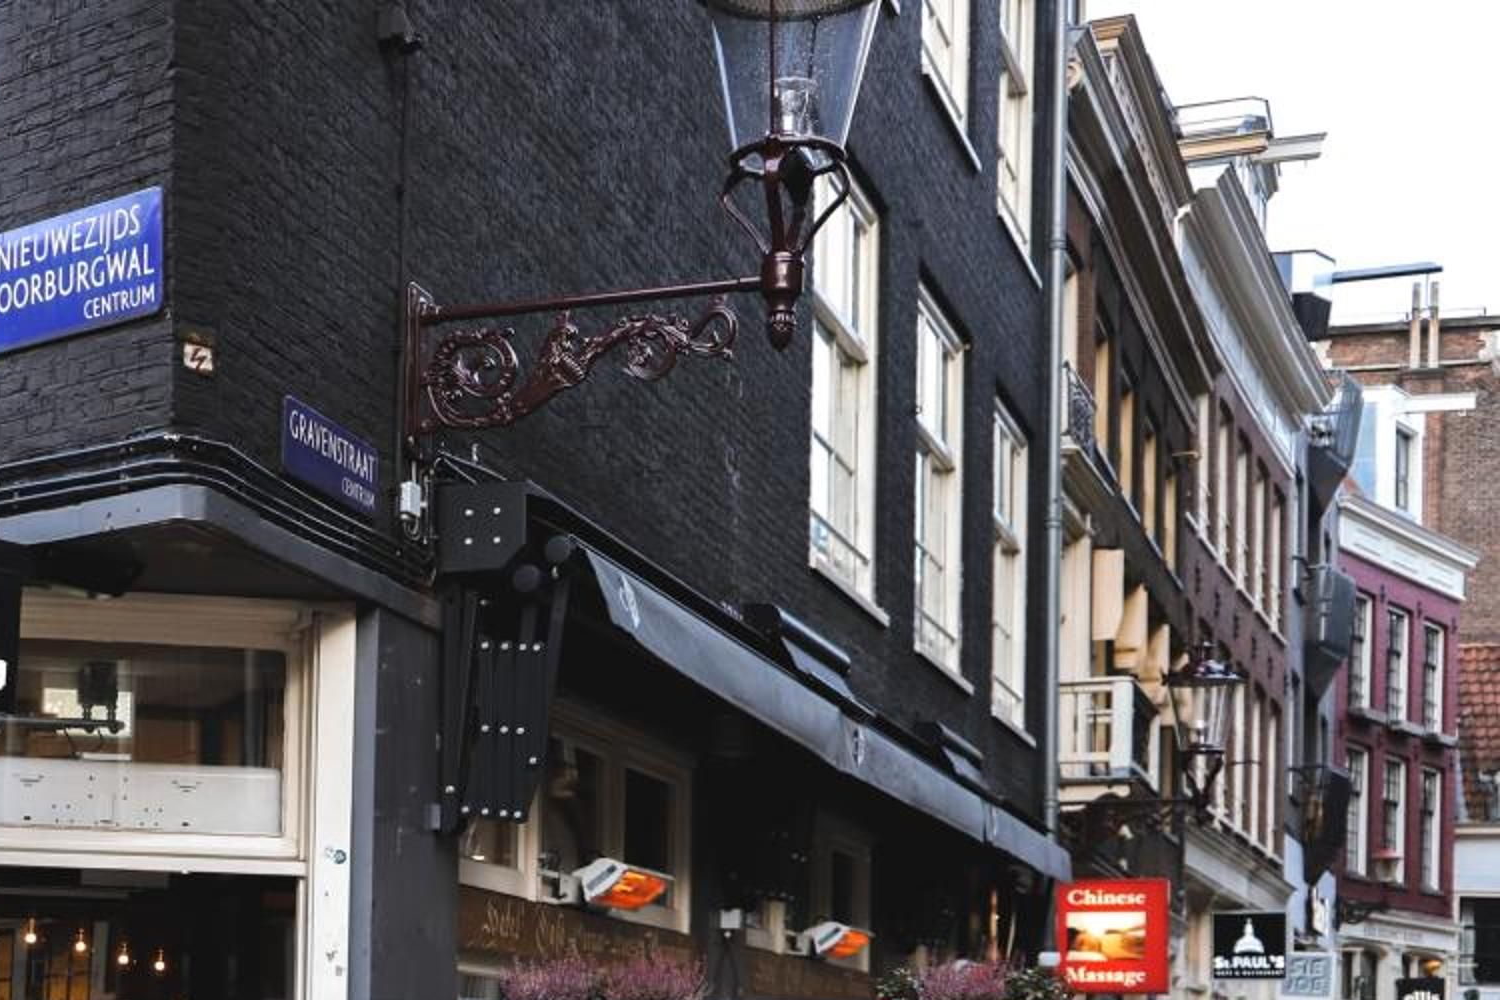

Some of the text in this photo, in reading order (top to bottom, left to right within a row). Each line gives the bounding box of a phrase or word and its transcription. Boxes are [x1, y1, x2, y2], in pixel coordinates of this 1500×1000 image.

[83, 283, 155, 319] CENTRUM
[289, 409, 375, 483] GRAVENSTRAAT
[342, 476, 375, 509] CENTRUM
[1067, 889, 1146, 905] Chinese
[1066, 966, 1146, 987] Massage
